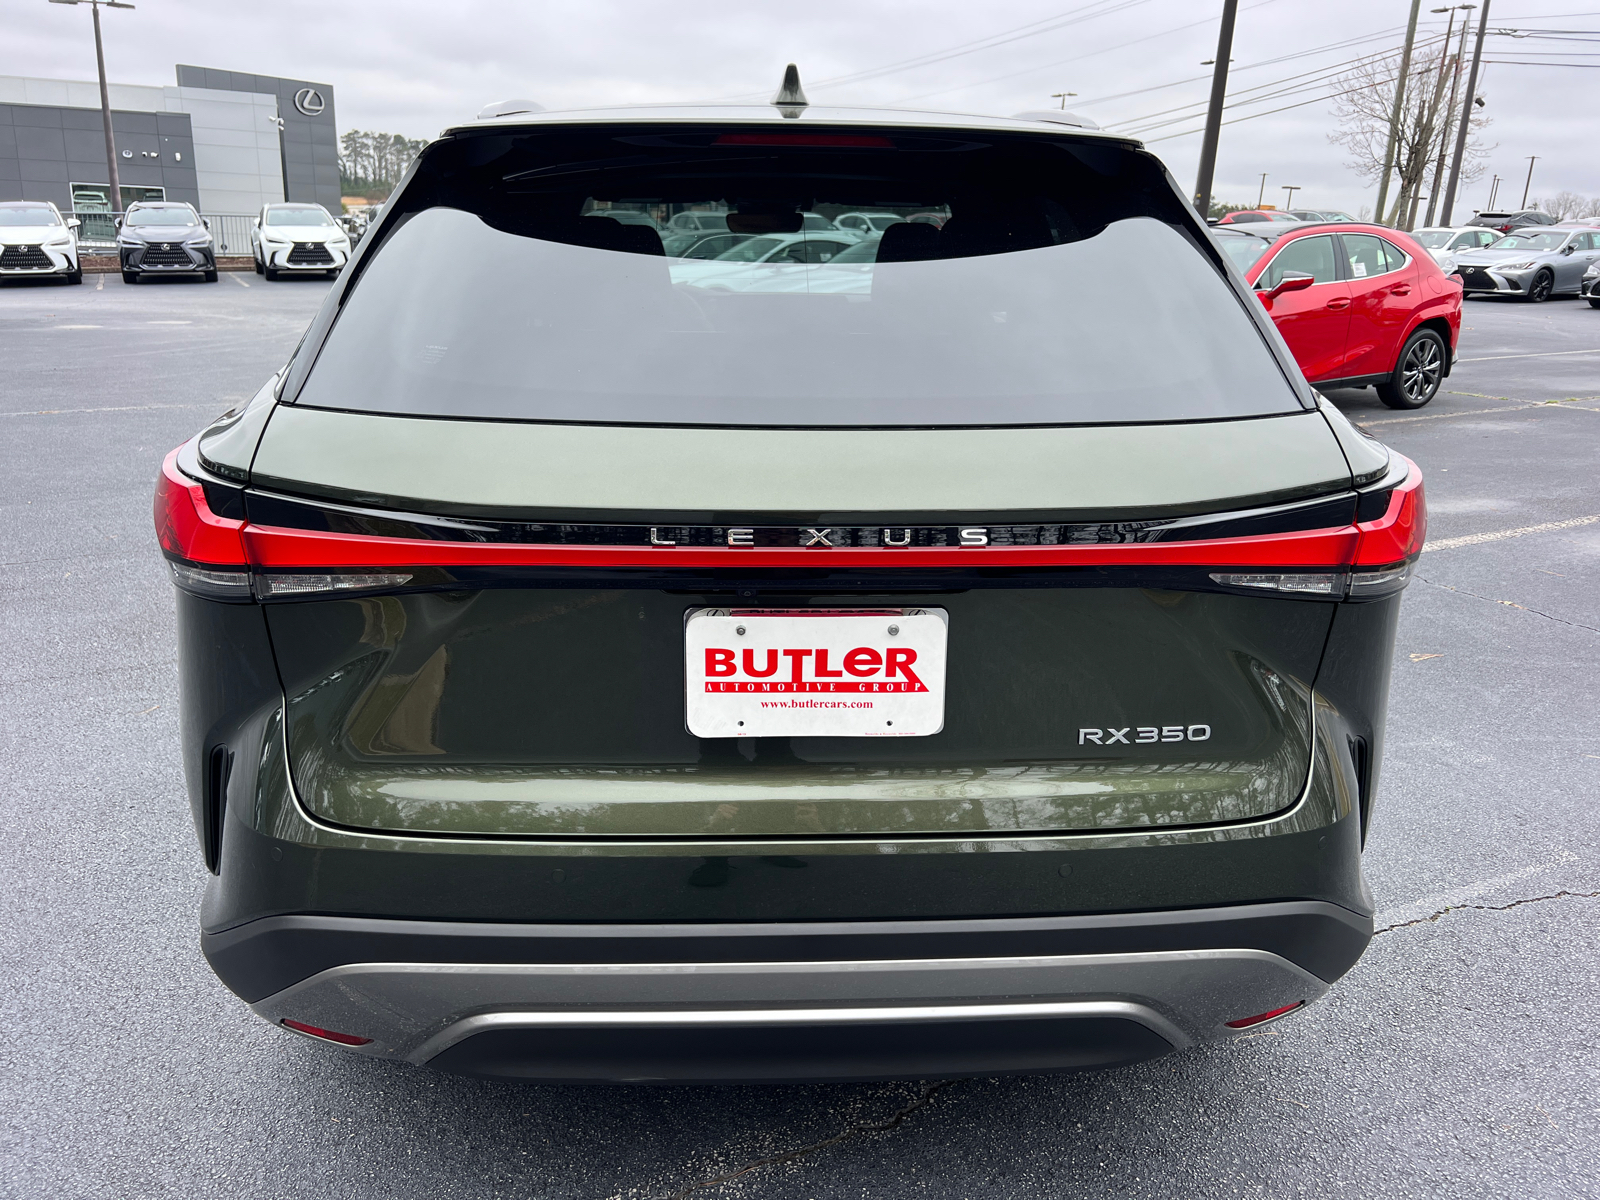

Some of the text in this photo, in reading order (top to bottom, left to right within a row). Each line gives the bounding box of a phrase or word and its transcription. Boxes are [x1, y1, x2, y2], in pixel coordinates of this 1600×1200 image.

[650, 527, 988, 546] LEXUS
[706, 682, 921, 692] AUTOMOTIVE GROUP
[760, 699, 874, 709] www.butlercars.com
